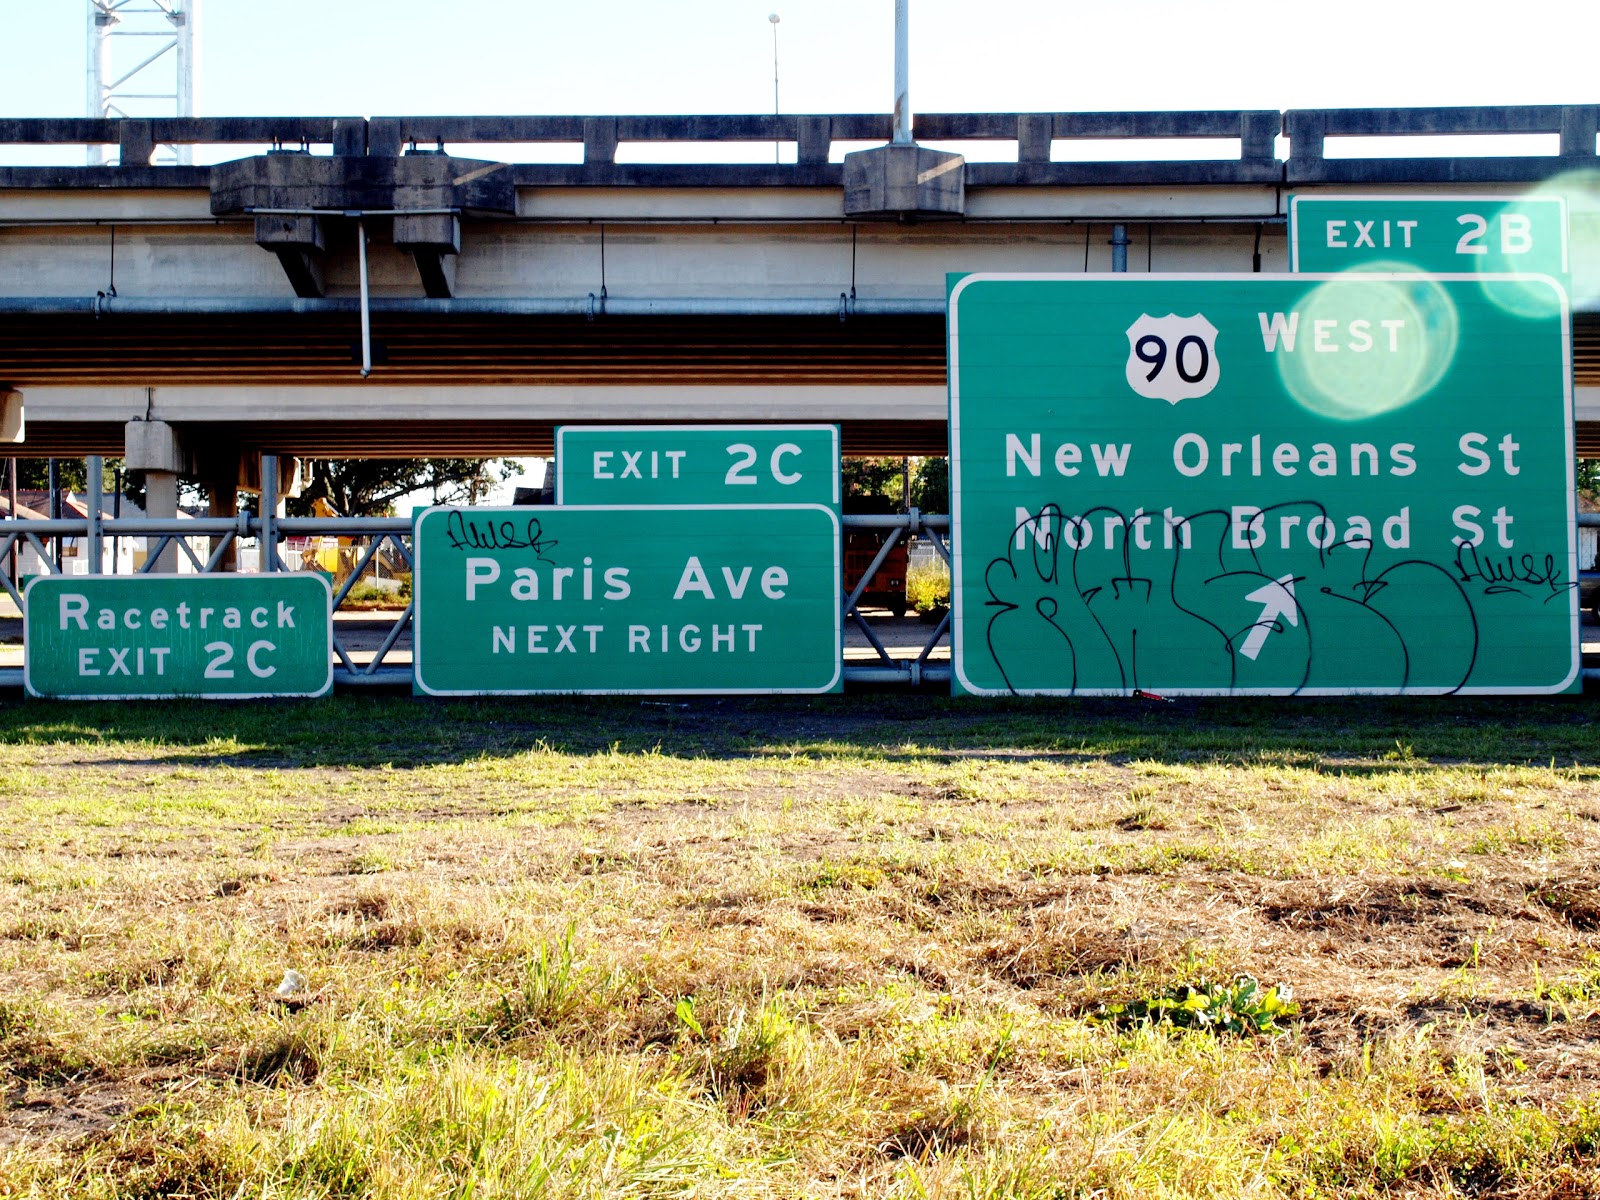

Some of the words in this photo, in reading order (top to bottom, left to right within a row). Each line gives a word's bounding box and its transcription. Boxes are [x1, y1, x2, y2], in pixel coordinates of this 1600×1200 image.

[1326, 219, 1418, 248] EXIT
[1456, 213, 1533, 255] 2B
[1258, 312, 1406, 354] WEST
[1135, 334, 1210, 384] 90
[593, 450, 687, 479] EXIT
[725, 442, 803, 485] 2C
[1005, 433, 1132, 477] New
[1173, 432, 1417, 477] Orleans
[1457, 432, 1521, 477] St
[1015, 506, 1192, 551] North
[1231, 505, 1410, 550] Broad
[1452, 504, 1514, 549] St
[465, 556, 631, 601] Paris
[673, 556, 789, 600] Ave
[59, 593, 296, 631] Racetrack
[78, 647, 171, 677] EXIT
[203, 640, 277, 679] 2C
[492, 625, 604, 654] NEXT
[628, 624, 763, 653] RIGHT
